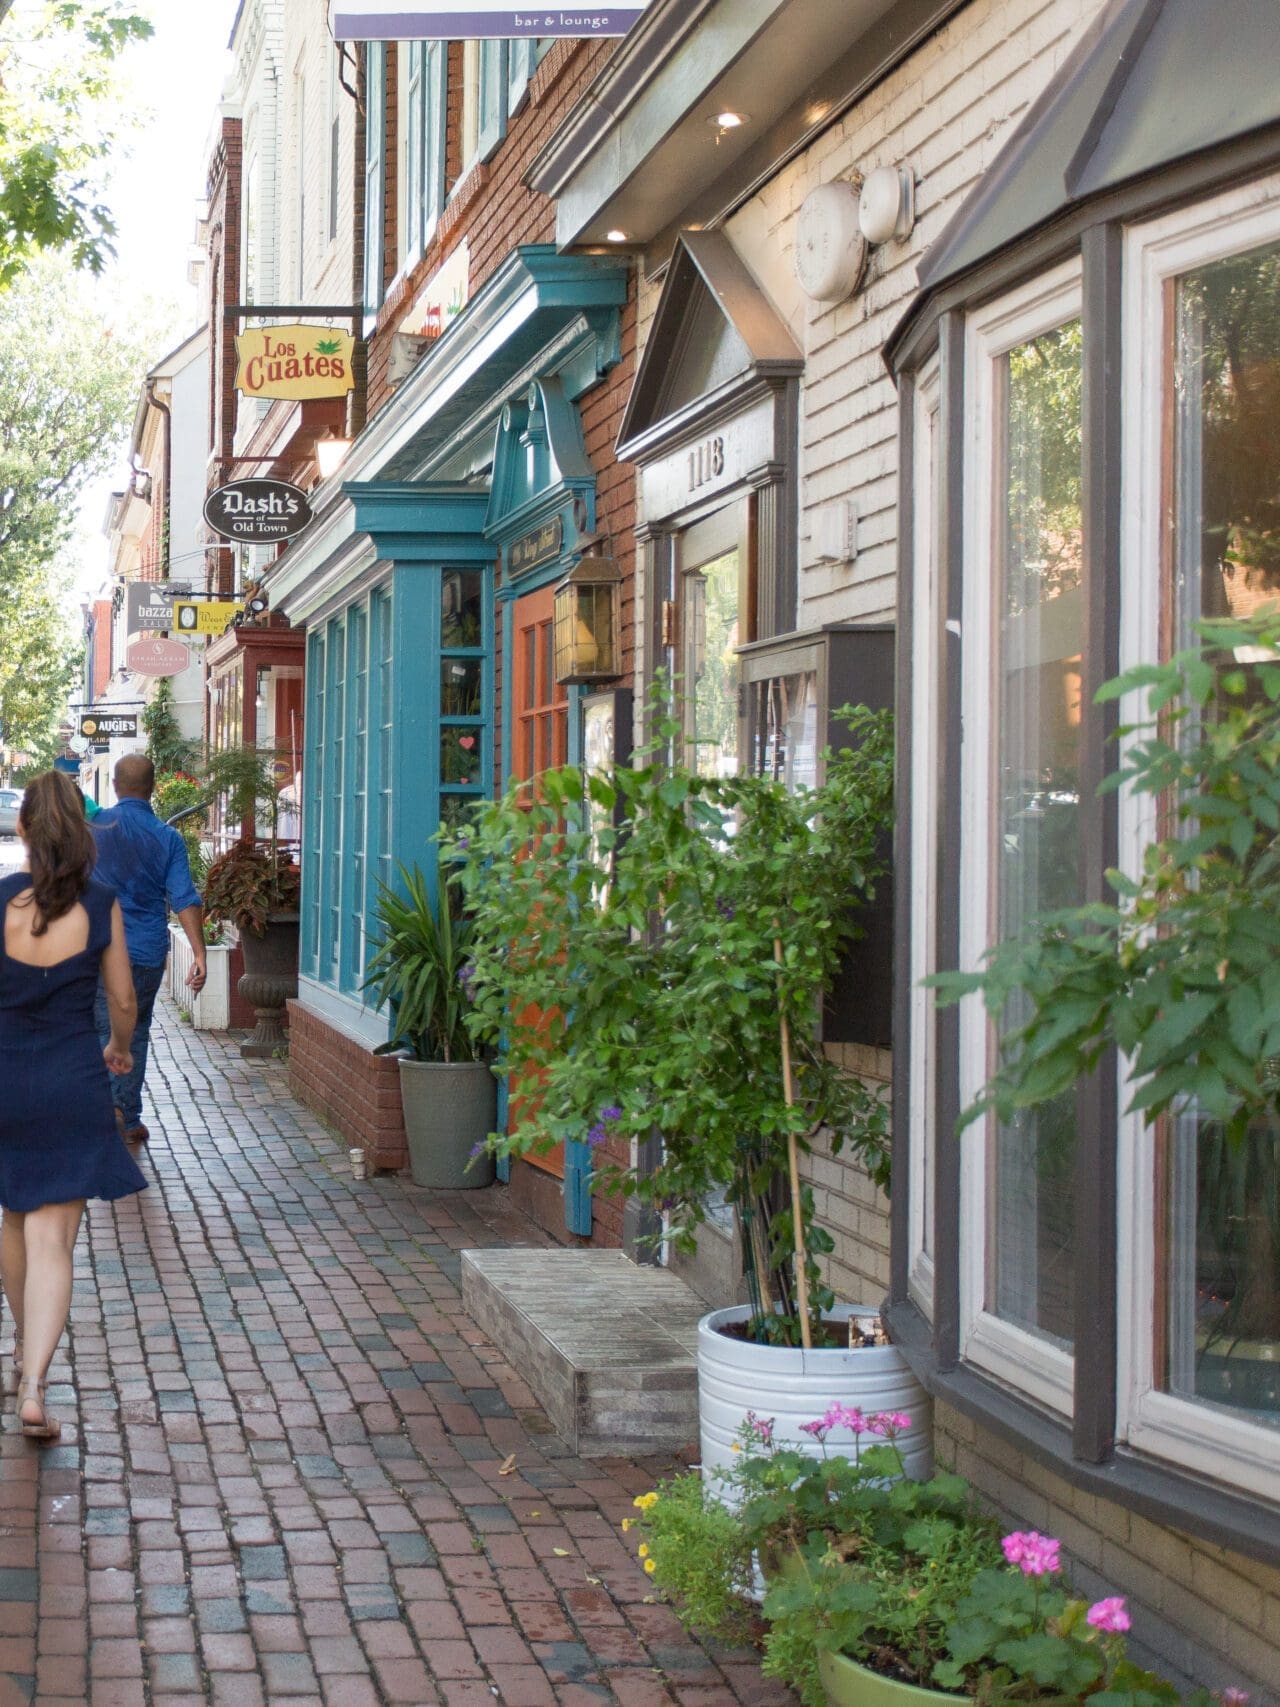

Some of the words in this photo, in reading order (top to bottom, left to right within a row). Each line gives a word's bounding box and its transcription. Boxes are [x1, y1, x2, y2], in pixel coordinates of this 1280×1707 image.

[514, 14, 539, 26] bar
[544, 16, 555, 26] &
[560, 13, 609, 28] lounge
[263, 335, 296, 358] Los
[246, 351, 345, 390] Cuates
[223, 490, 299, 514] Dash's
[256, 514, 266, 522] of
[233, 522, 254, 532] Old
[256, 522, 288, 532] Town
[138, 605, 173, 617] bazza
[99, 720, 136, 731] AUGIE'S
